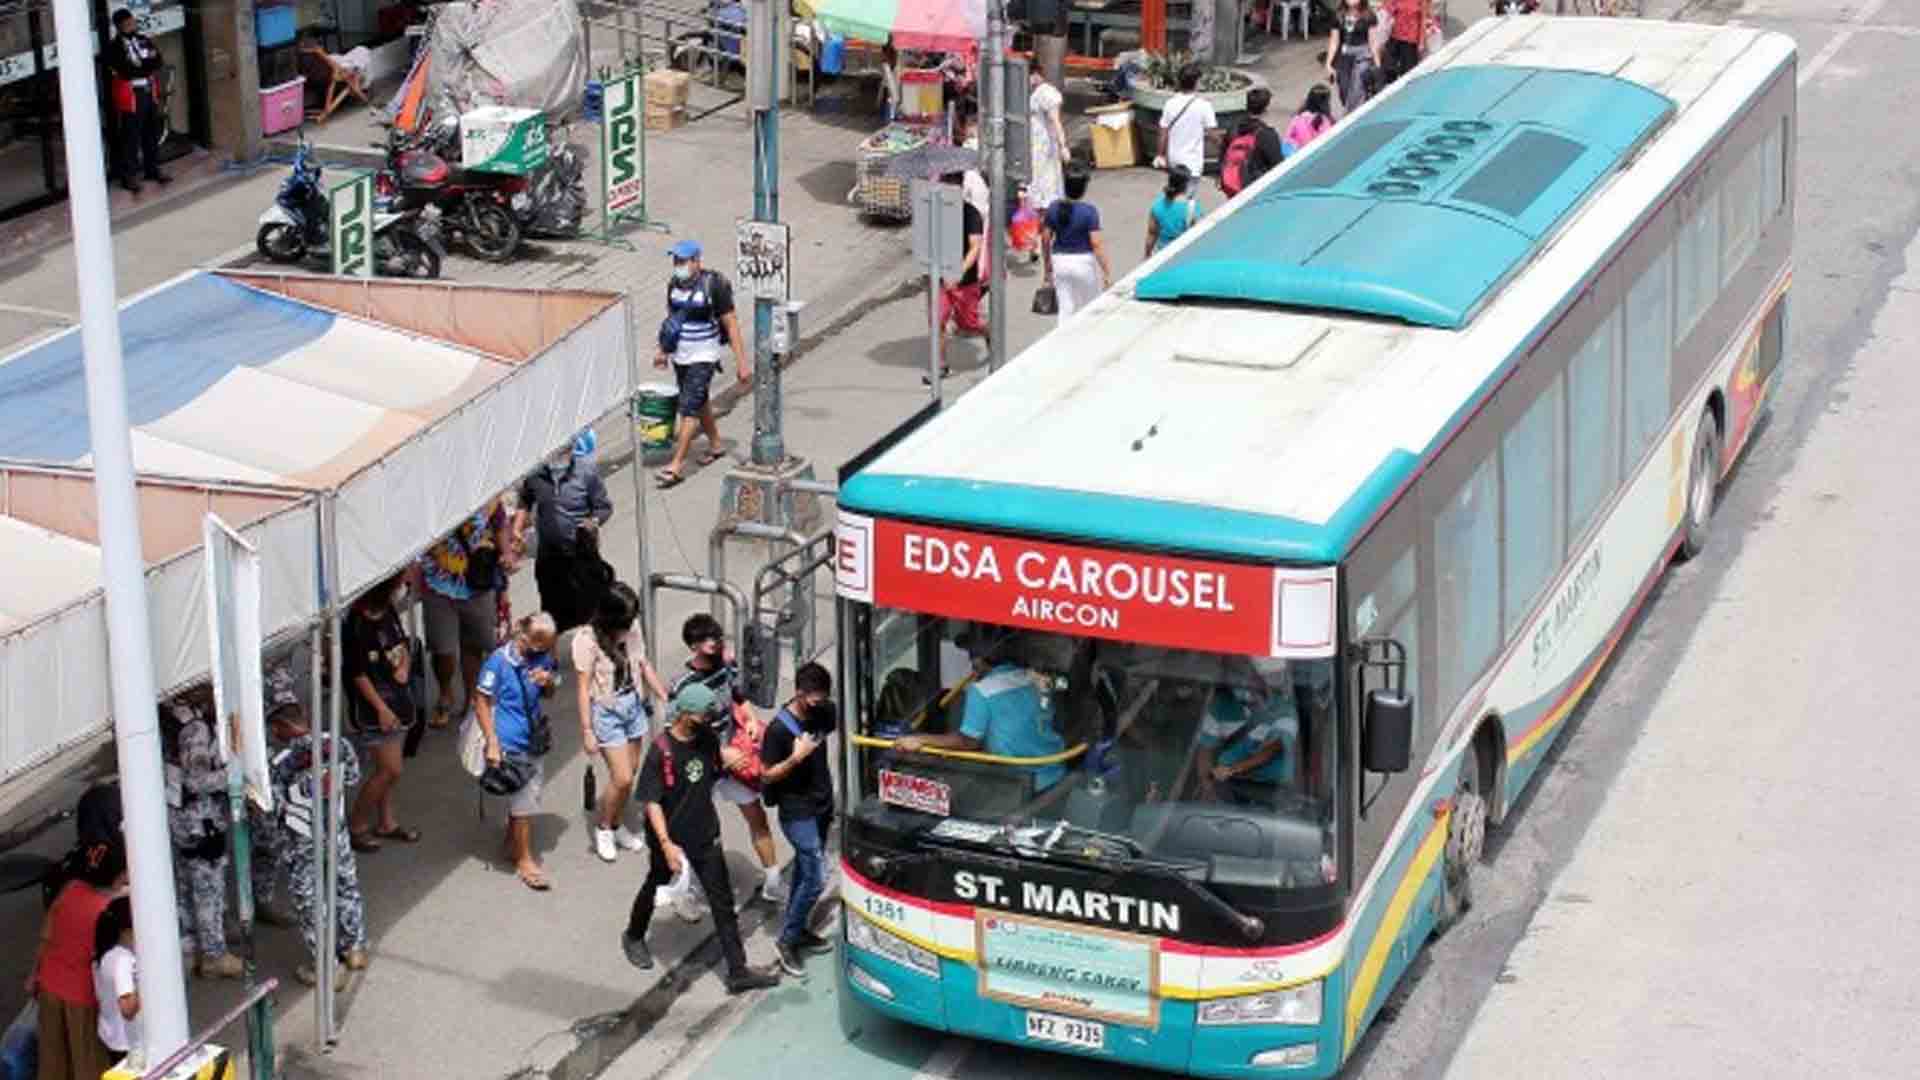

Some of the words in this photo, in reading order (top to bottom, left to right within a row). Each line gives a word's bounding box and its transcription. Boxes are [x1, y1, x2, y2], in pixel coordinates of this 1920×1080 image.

[610, 79, 636, 185] JRS
[904, 534, 1002, 583] EDSA
[1014, 551, 1234, 612] CAROUSEL
[1011, 597, 1121, 630] AIRCON
[953, 871, 1009, 905] ST.
[1022, 881, 1181, 932] MARTIN
